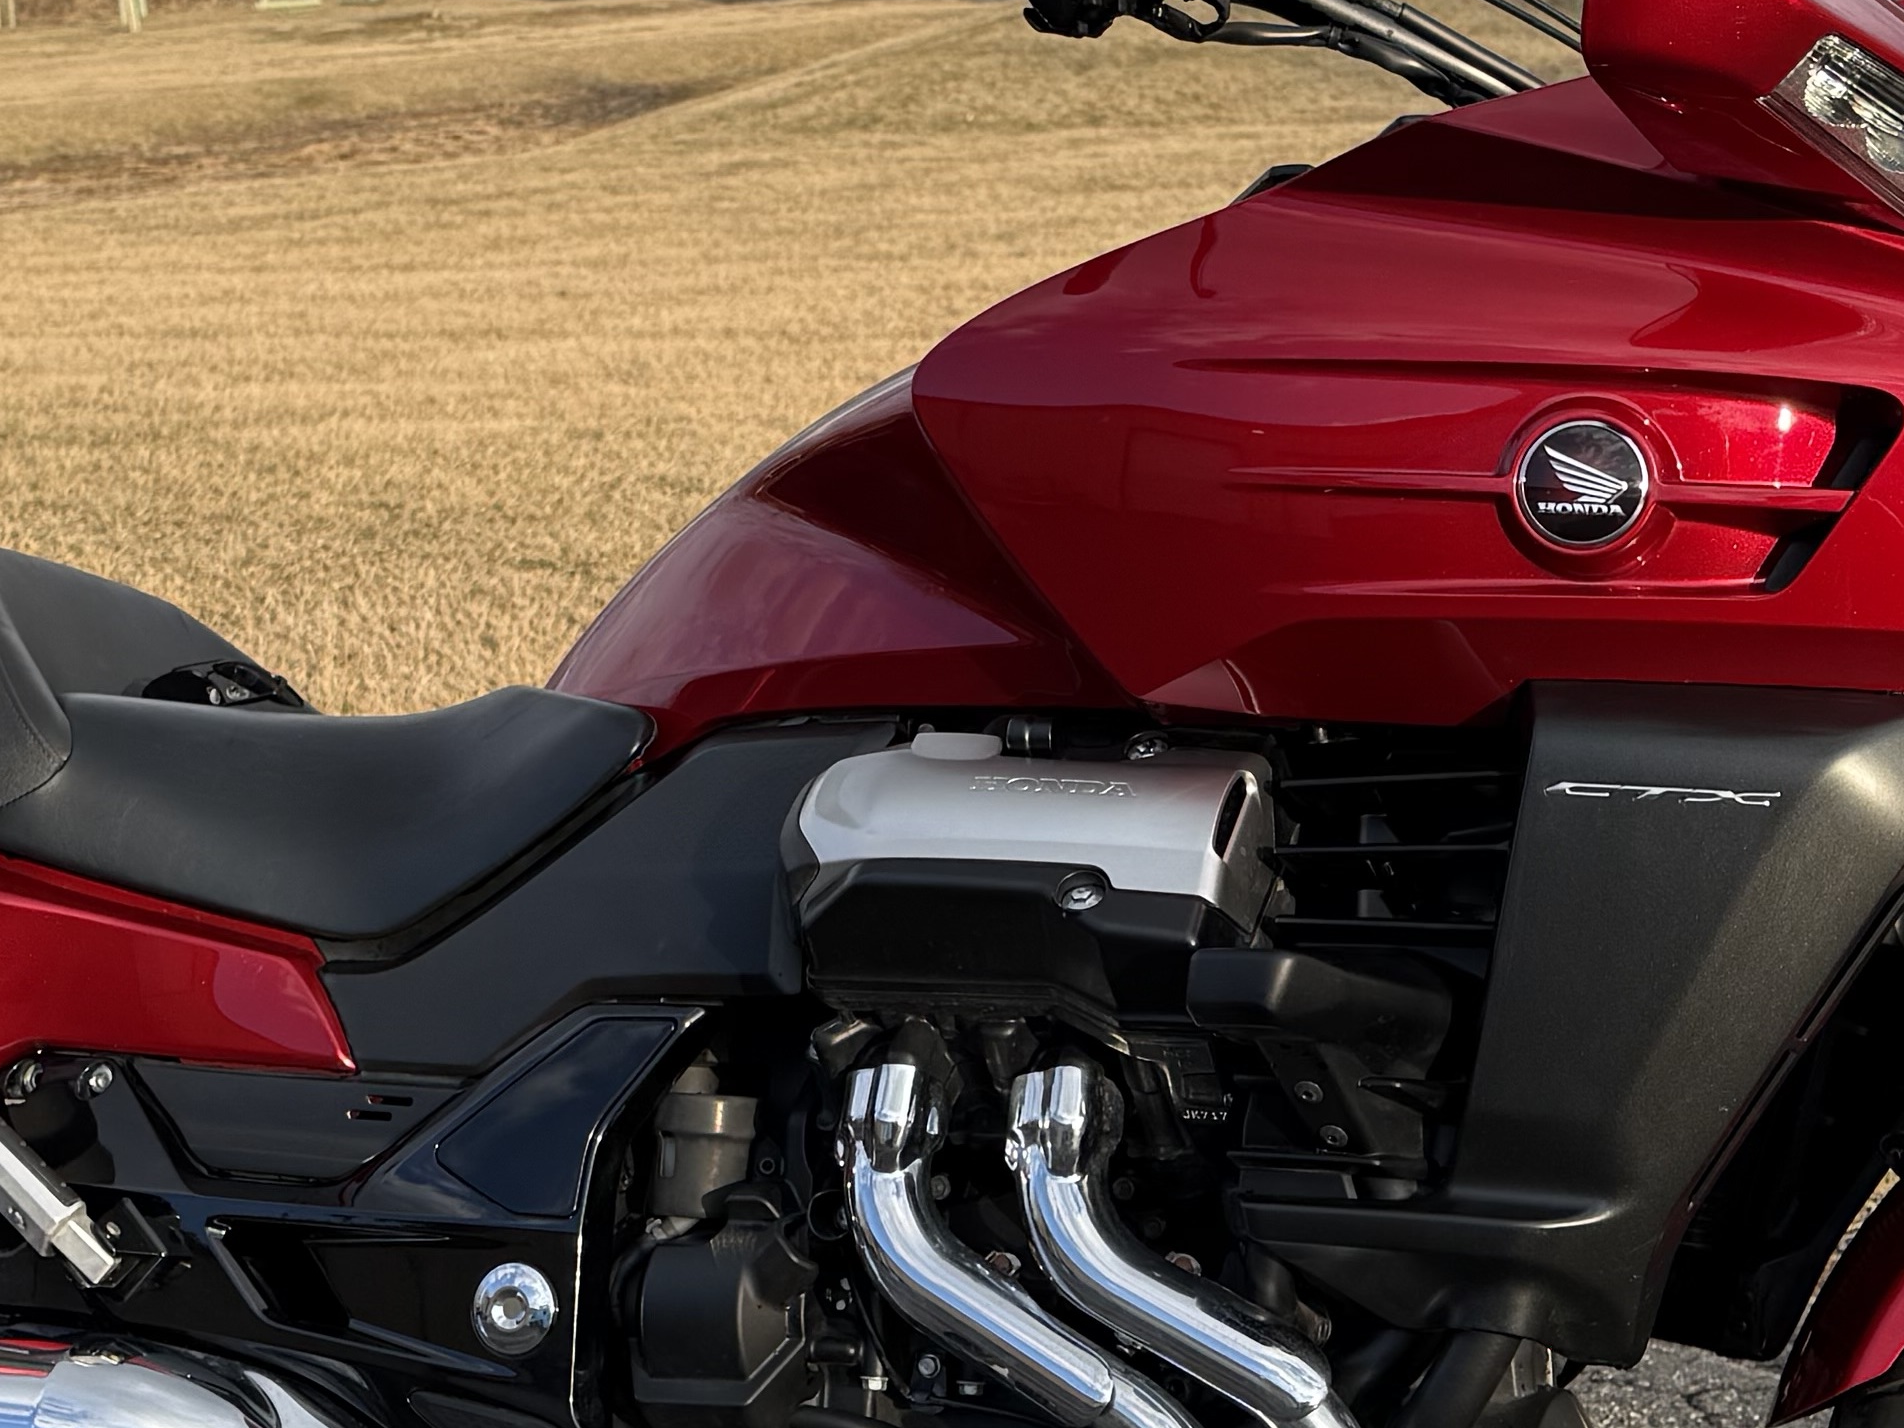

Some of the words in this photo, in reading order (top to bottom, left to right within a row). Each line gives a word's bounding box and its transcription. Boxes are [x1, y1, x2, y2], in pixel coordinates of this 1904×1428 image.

[1537, 501, 1626, 516] HONDA
[969, 776, 1137, 797] HONDA
[1543, 781, 1782, 807] CTX
